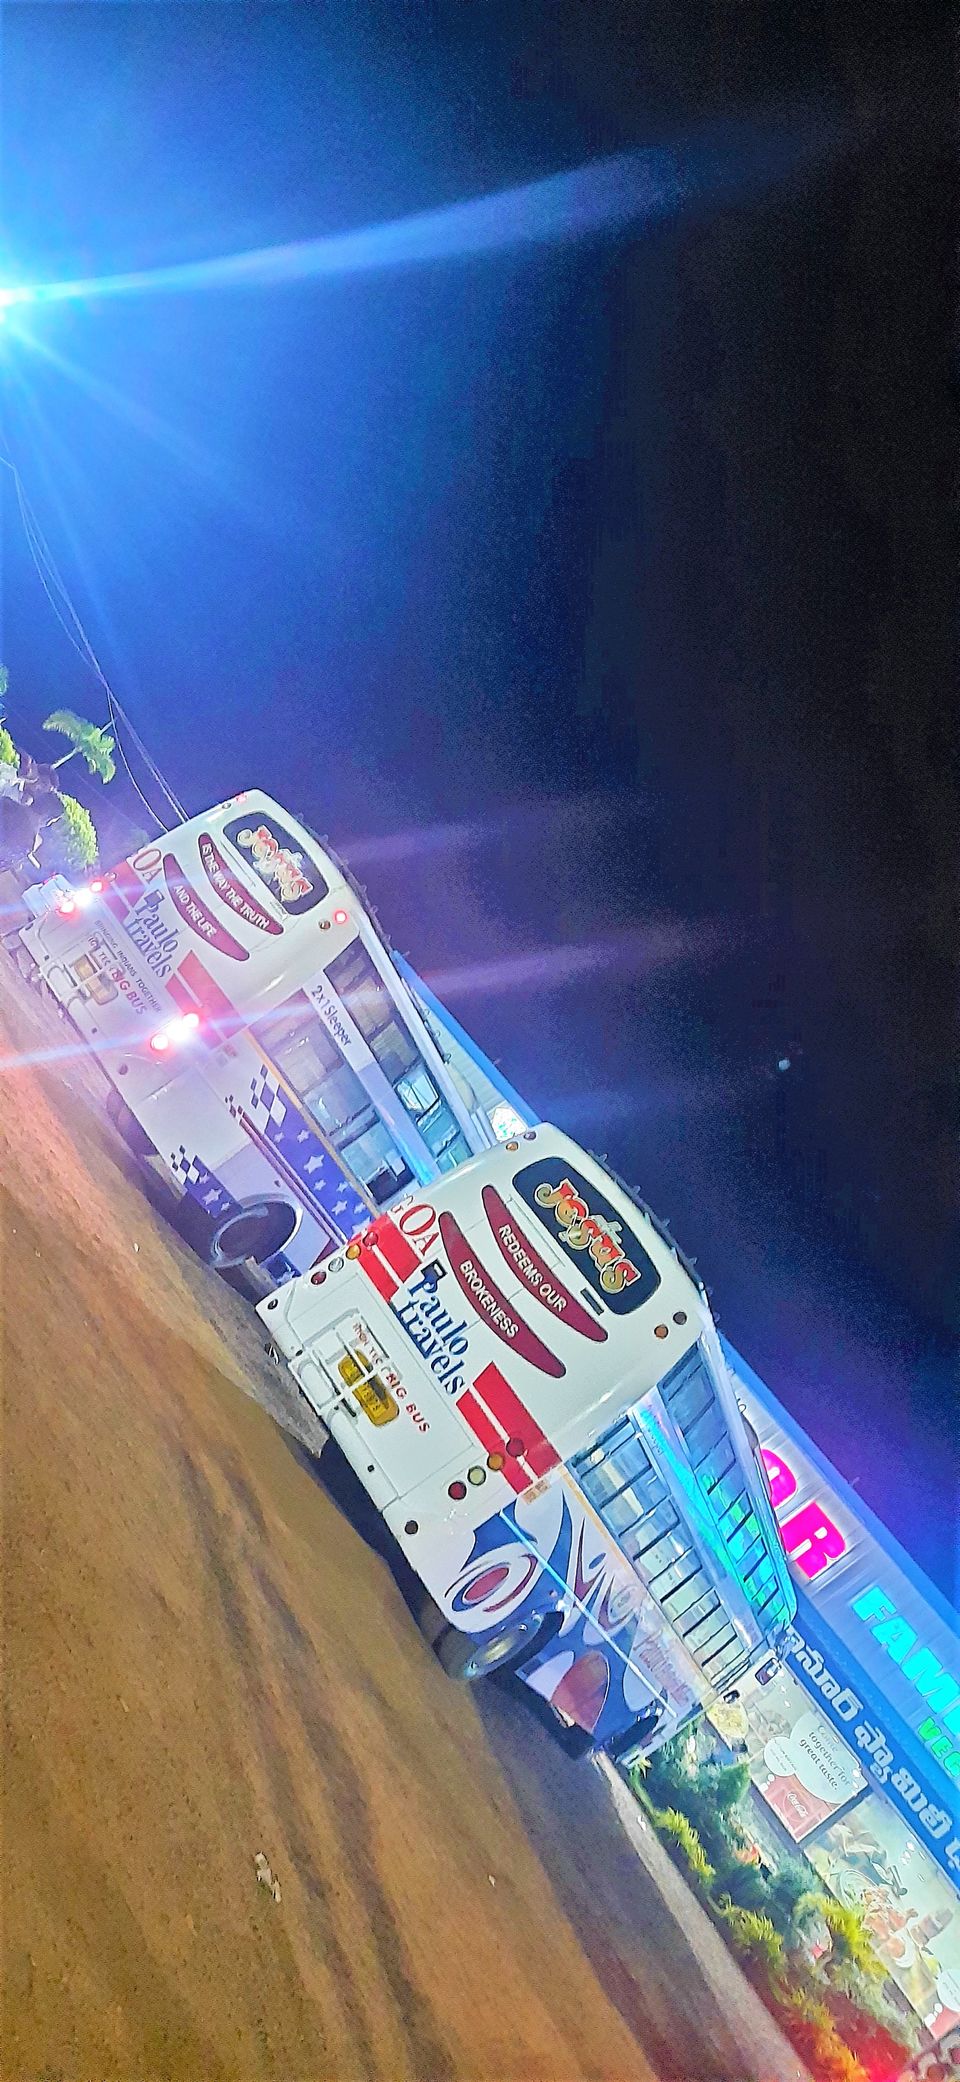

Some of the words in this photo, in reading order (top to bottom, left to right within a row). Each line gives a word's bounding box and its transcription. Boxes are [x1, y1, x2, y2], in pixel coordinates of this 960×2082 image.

[134, 889, 179, 953] Paulo
[174, 884, 191, 905] AND
[203, 853, 220, 873] THE
[213, 871, 231, 891] WAY
[226, 888, 244, 908] THE
[240, 903, 271, 930] TRUTH
[125, 917, 172, 978] travels
[125, 990, 148, 1015] BUS
[391, 1193, 440, 1257] GOA
[534, 1177, 642, 1294] Jesus
[459, 1260, 519, 1338] BROKENESS
[498, 1224, 543, 1289] REDEEMS
[538, 1282, 569, 1313] OUR
[407, 1259, 469, 1356] Paulo
[397, 1297, 466, 1395] travels
[385, 1372, 408, 1400] BIG
[405, 1402, 431, 1433] BUS
[799, 1738, 821, 1765] great
[807, 1731, 841, 1772] together
